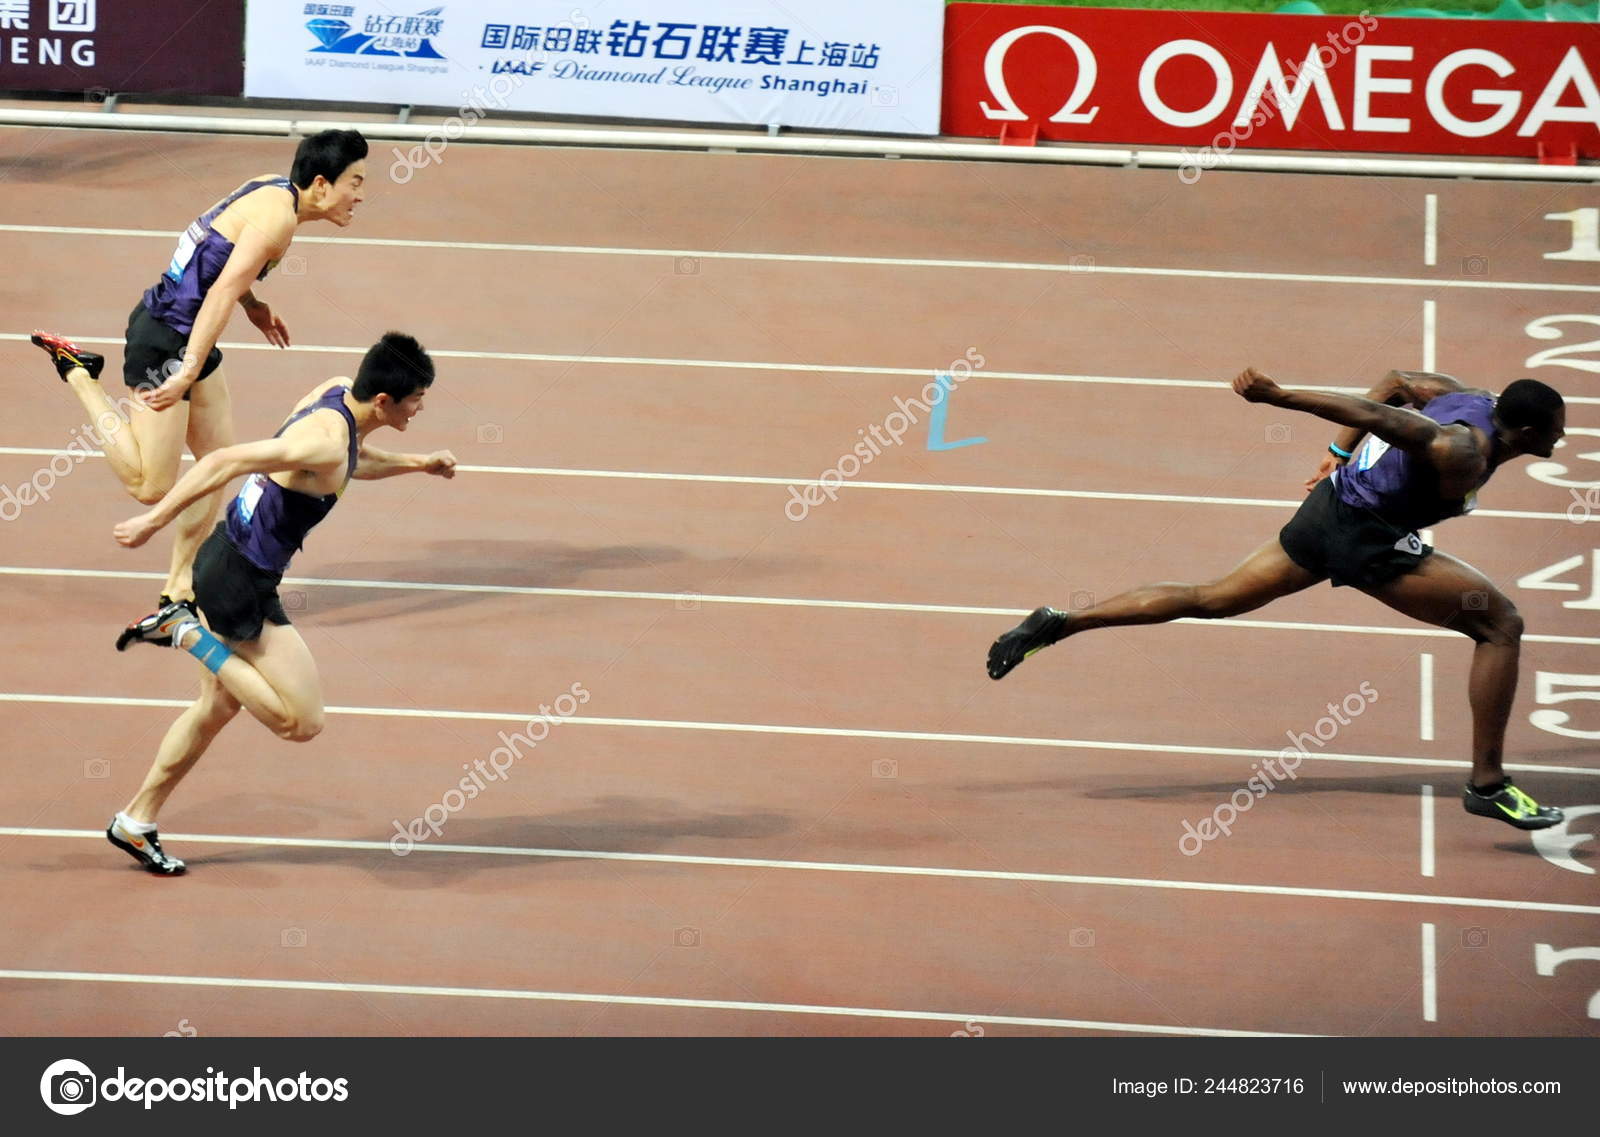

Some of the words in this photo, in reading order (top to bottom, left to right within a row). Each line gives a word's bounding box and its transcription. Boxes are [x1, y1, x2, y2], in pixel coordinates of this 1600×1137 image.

[364, 14, 444, 36] 钻石联赛
[0, 37, 95, 67] ENG
[328, 59, 370, 70] Diamond
[372, 62, 405, 73] League
[491, 60, 545, 76] IAAF
[551, 59, 668, 85] Diamond
[667, 65, 753, 94] League
[760, 74, 868, 97] Shanghai
[1138, 38, 1600, 138] OMEGA
[1407, 535, 1420, 550] 6
